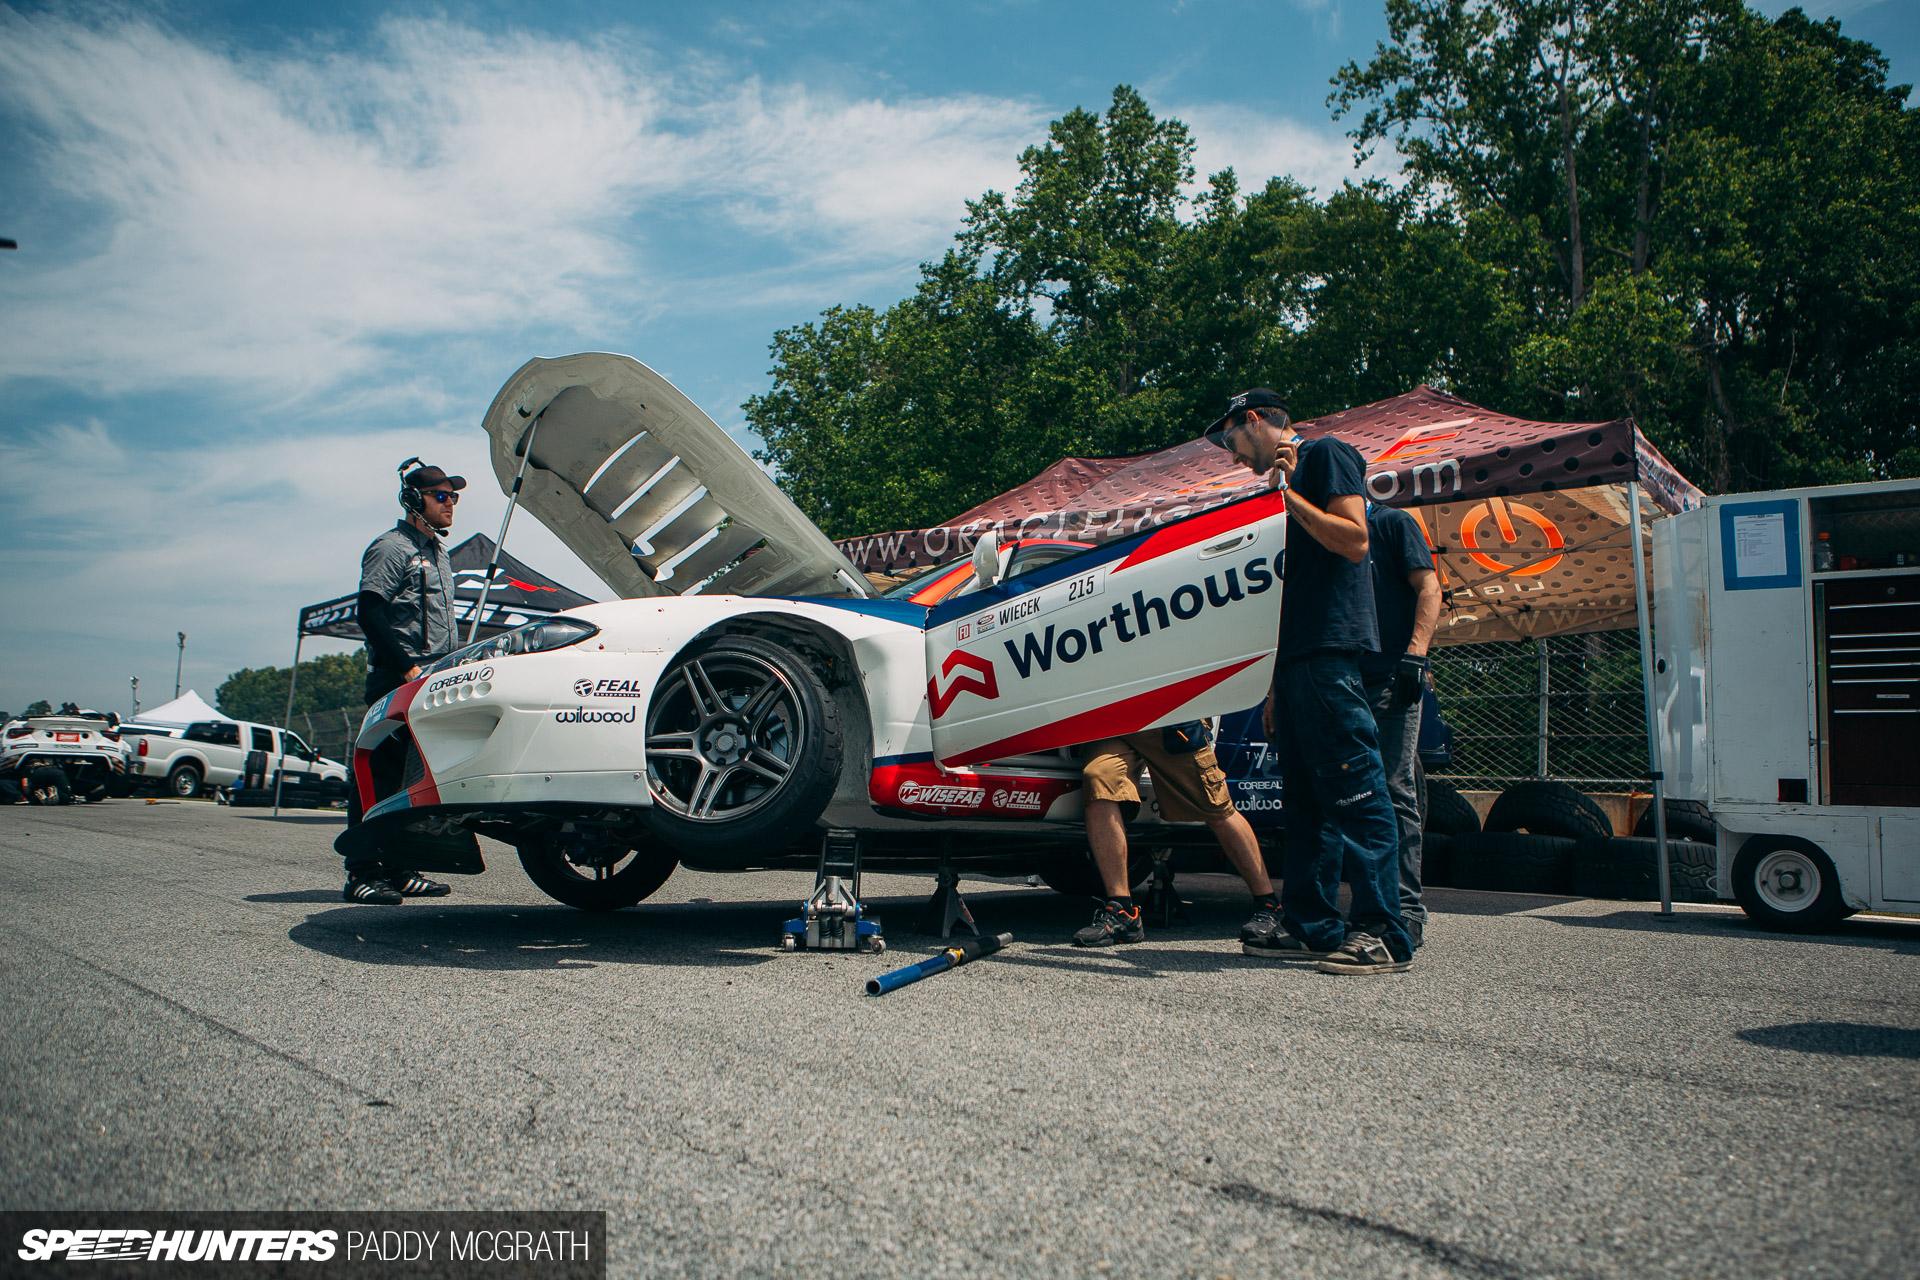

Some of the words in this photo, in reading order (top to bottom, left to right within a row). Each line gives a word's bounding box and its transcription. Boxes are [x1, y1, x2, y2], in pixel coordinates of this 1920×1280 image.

[999, 596, 1041, 626] WIECEK
[1068, 575, 1095, 602] 215
[429, 671, 479, 693] CORBEAU
[595, 679, 641, 692] FEAL
[555, 705, 636, 723] wilwood
[1246, 751, 1278, 761] TWE
[919, 787, 986, 804] WISEFAB
[1008, 790, 1041, 804] FEAL
[1235, 794, 1283, 811] wilwo
